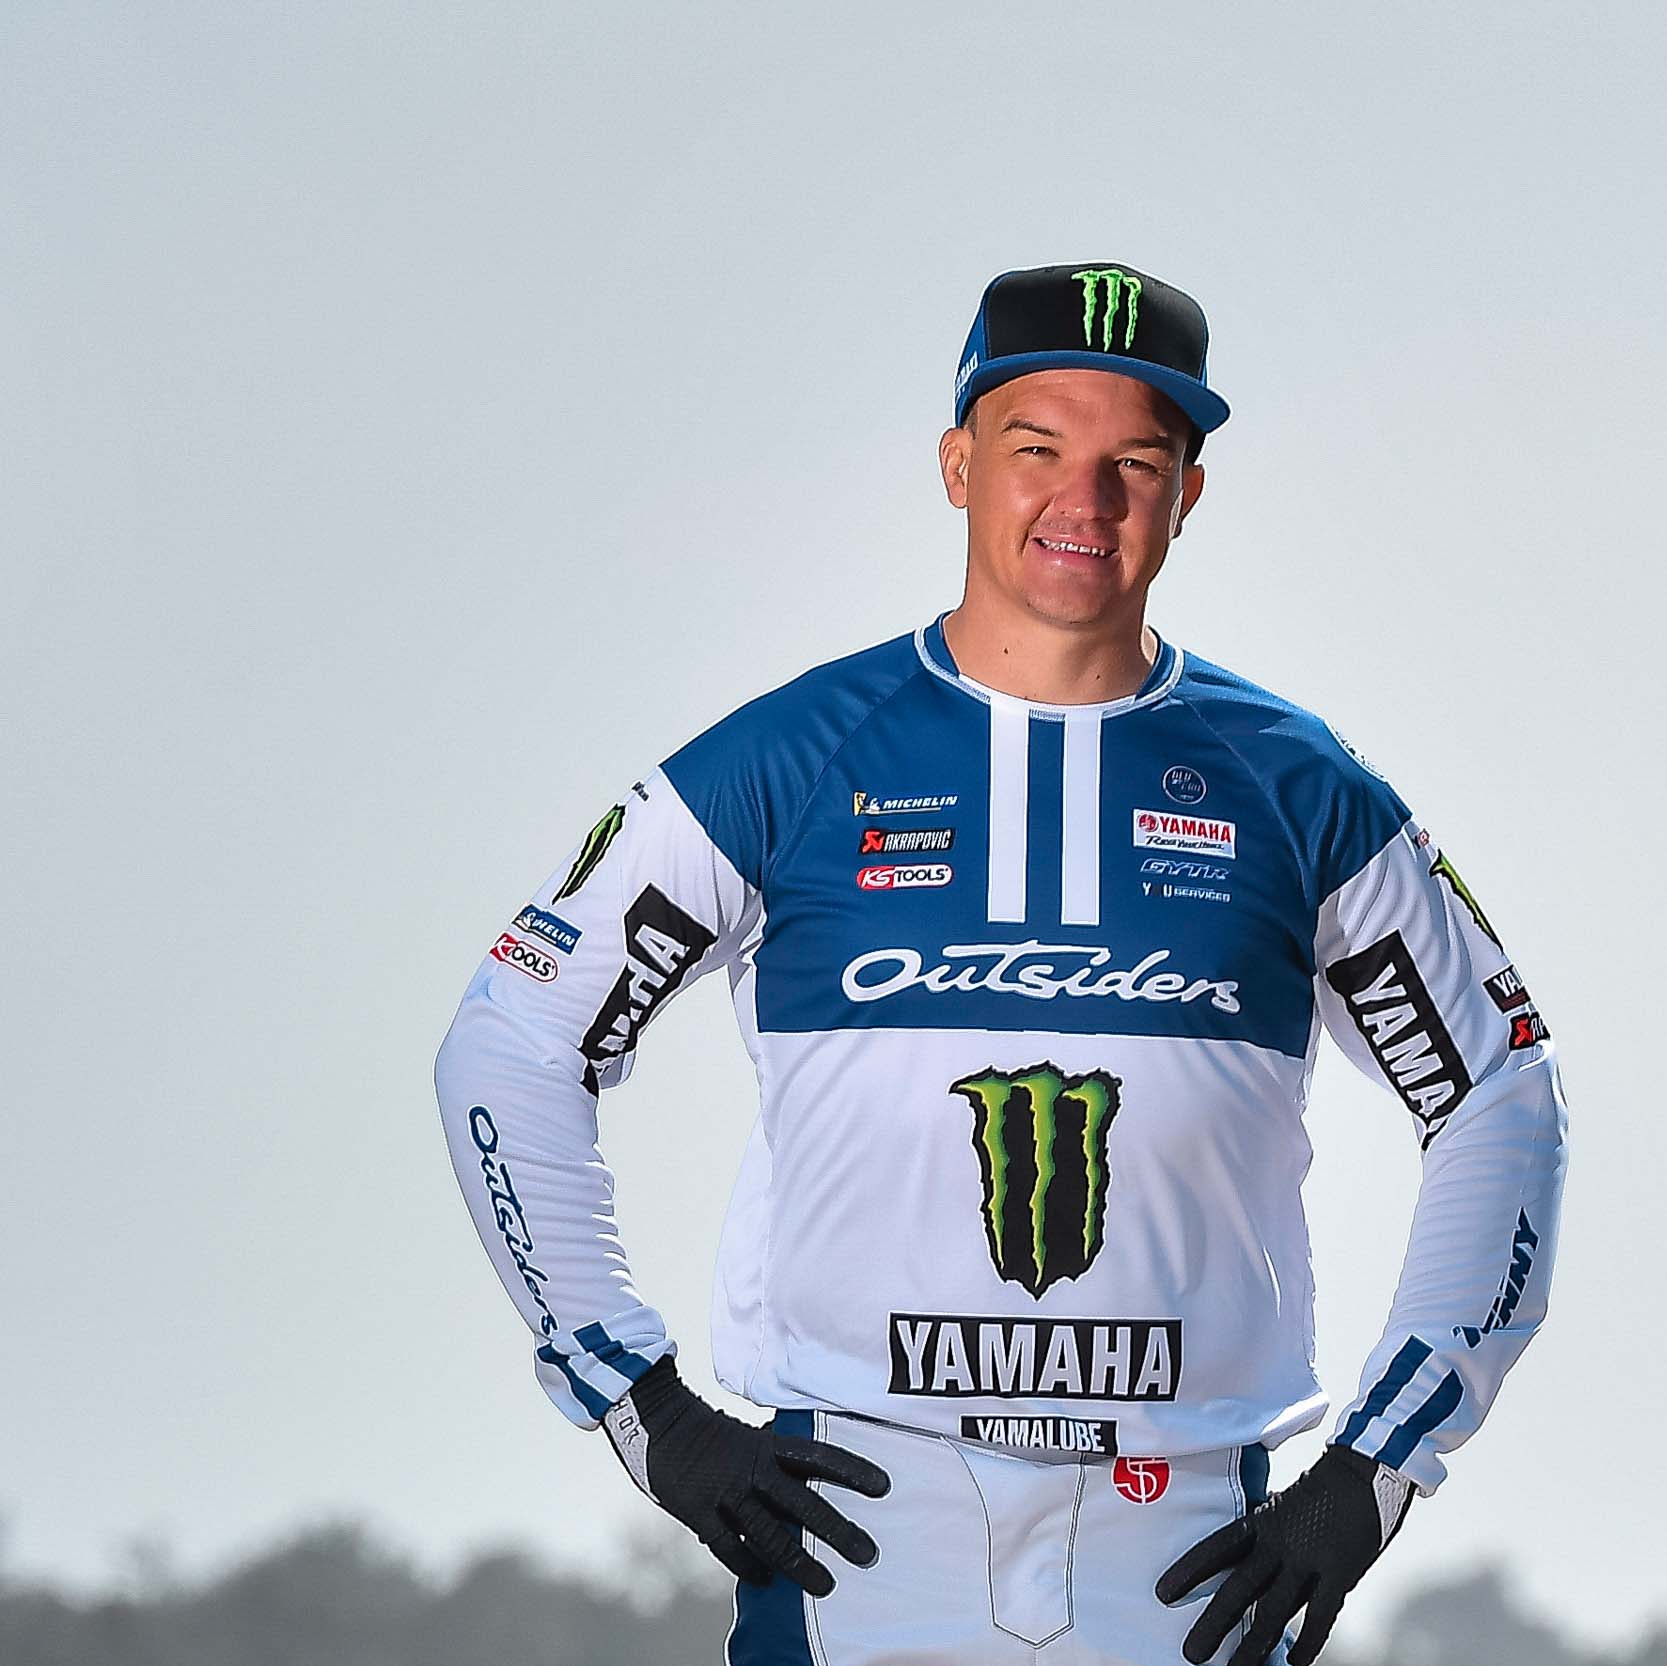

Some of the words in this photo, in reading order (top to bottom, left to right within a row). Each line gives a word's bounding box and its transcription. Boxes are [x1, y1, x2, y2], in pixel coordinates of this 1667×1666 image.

[883, 796, 958, 809] MICHELIN
[1160, 816, 1232, 843] YAMAHA
[862, 869, 896, 888] KS
[895, 868, 949, 882] TOOLS
[1140, 858, 1232, 880] GYTR
[511, 946, 552, 977] OOLS
[841, 939, 1241, 1015] Outsiders
[1350, 962, 1456, 1133] YAMA
[468, 1104, 559, 1337] Outsiders
[896, 1319, 1174, 1396] YAMAHA
[976, 1419, 1106, 1452] YAMALUBE
